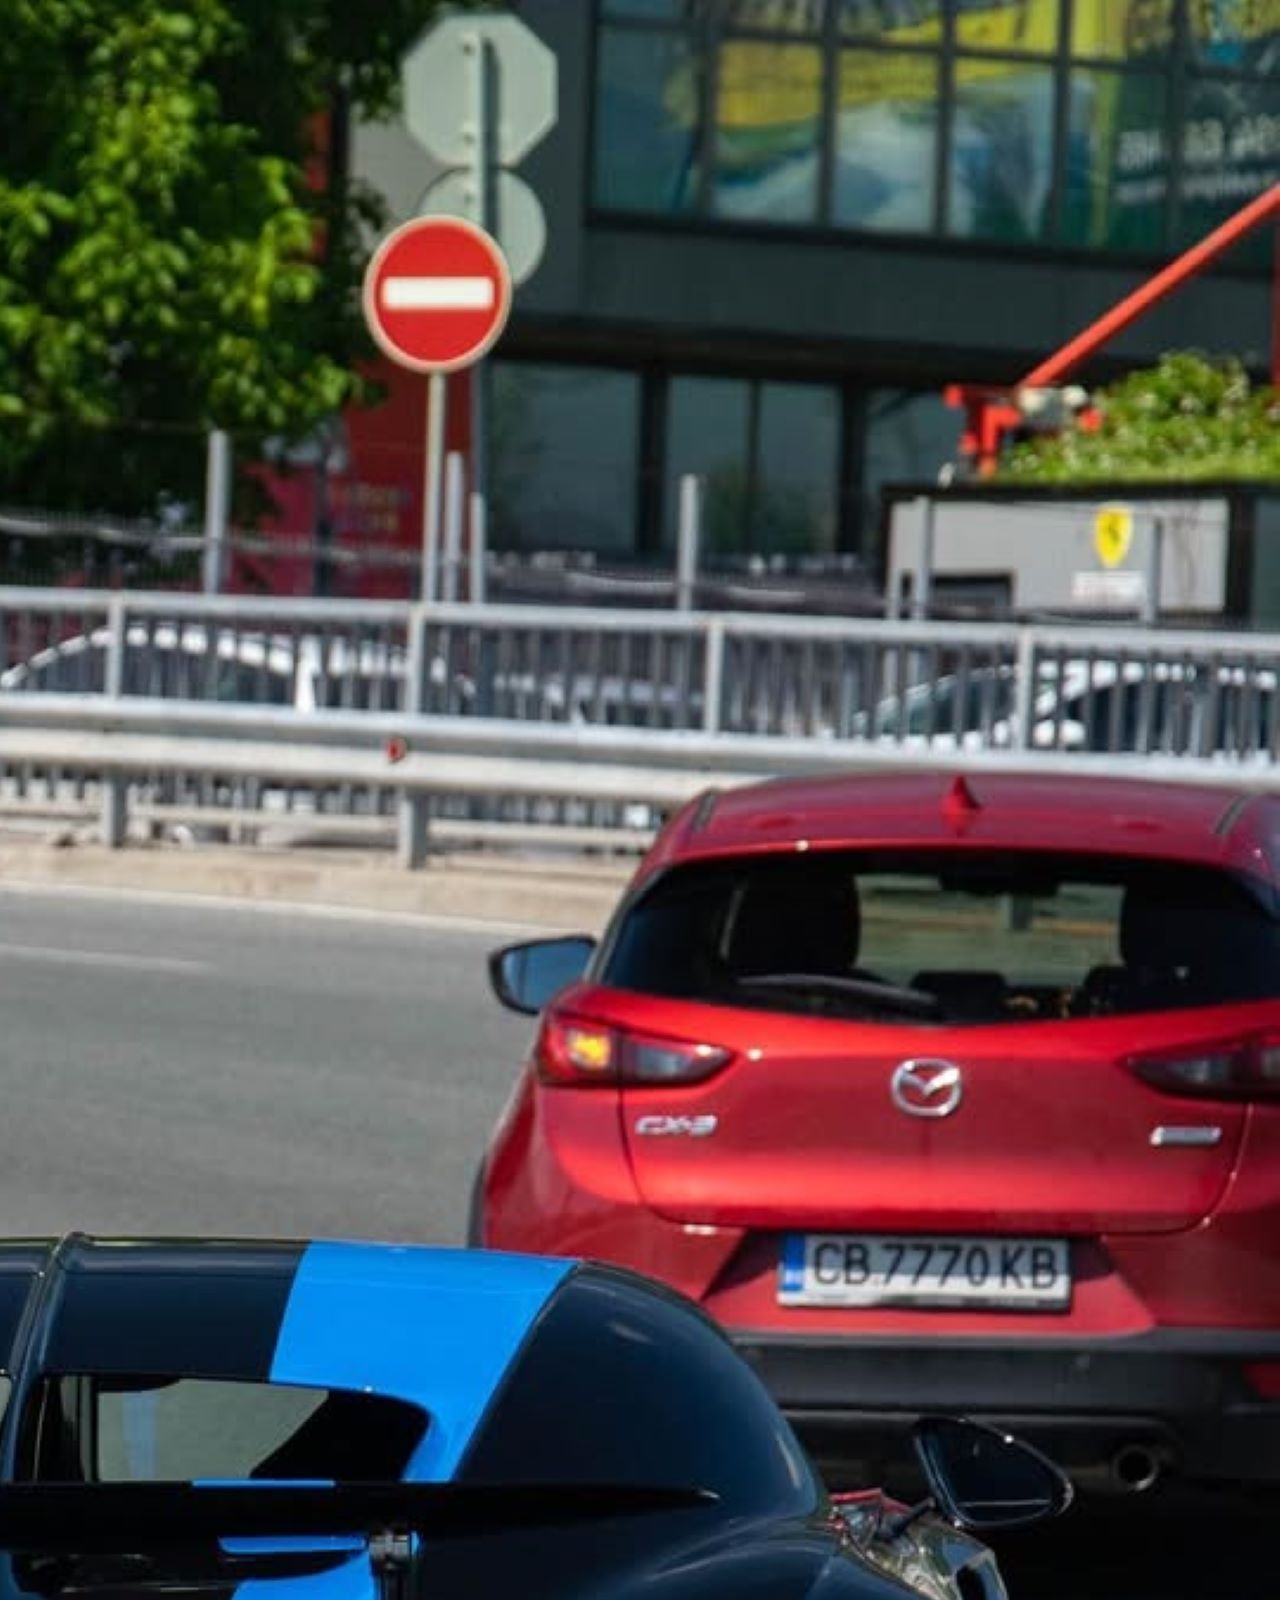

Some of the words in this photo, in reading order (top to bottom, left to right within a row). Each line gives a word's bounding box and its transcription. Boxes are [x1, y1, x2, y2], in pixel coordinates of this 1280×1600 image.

[814, 1242, 870, 1286] CB
[881, 1243, 990, 1287] 7770
[1001, 1245, 1058, 1290] KB
